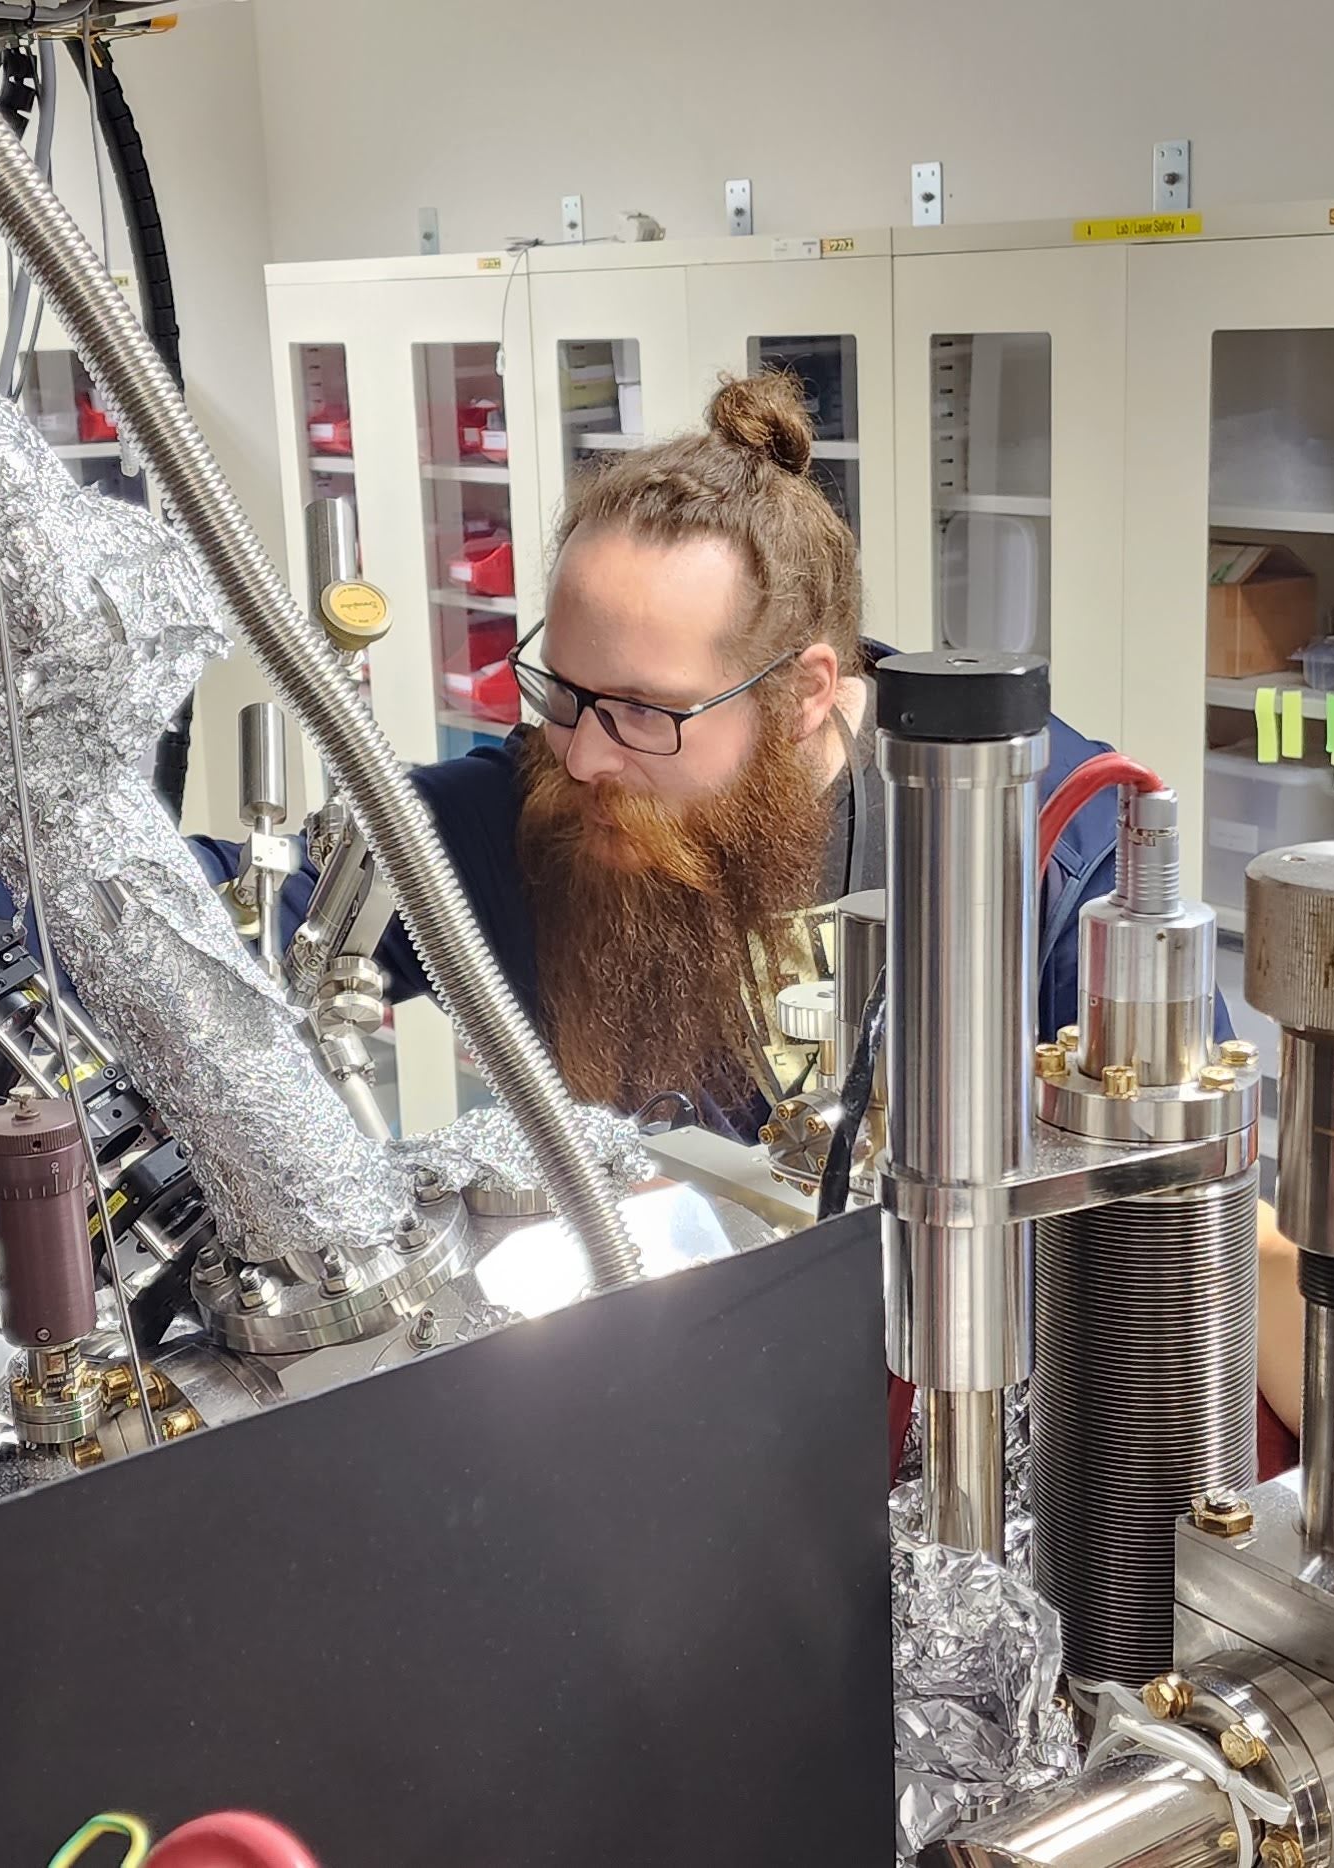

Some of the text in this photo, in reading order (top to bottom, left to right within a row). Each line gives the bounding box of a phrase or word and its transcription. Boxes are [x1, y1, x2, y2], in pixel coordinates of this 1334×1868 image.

[1117, 222, 1129, 235] Lab
[1134, 221, 1152, 234] Laser
[1153, 219, 1175, 234] Safety
